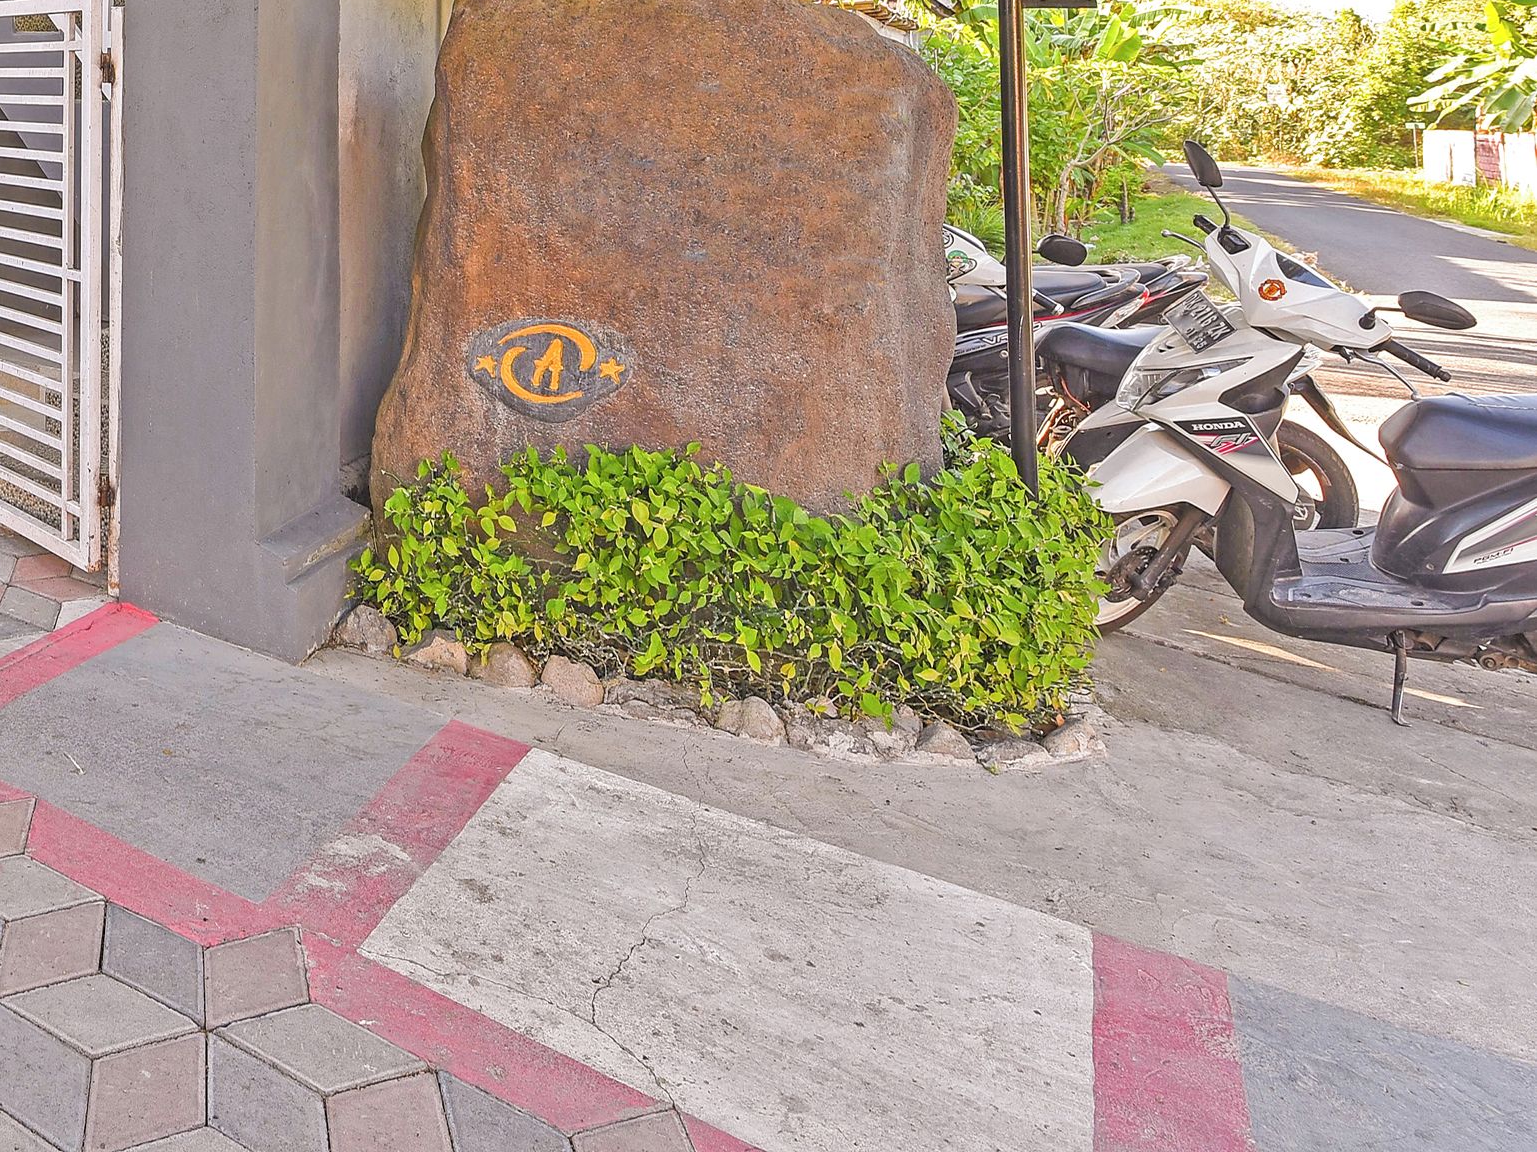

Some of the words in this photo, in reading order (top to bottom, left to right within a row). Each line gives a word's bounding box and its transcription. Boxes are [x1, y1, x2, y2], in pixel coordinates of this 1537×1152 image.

[1190, 304, 1219, 328] 2716
[1207, 321, 1231, 340] ZK
[1191, 421, 1246, 431] HONDA
